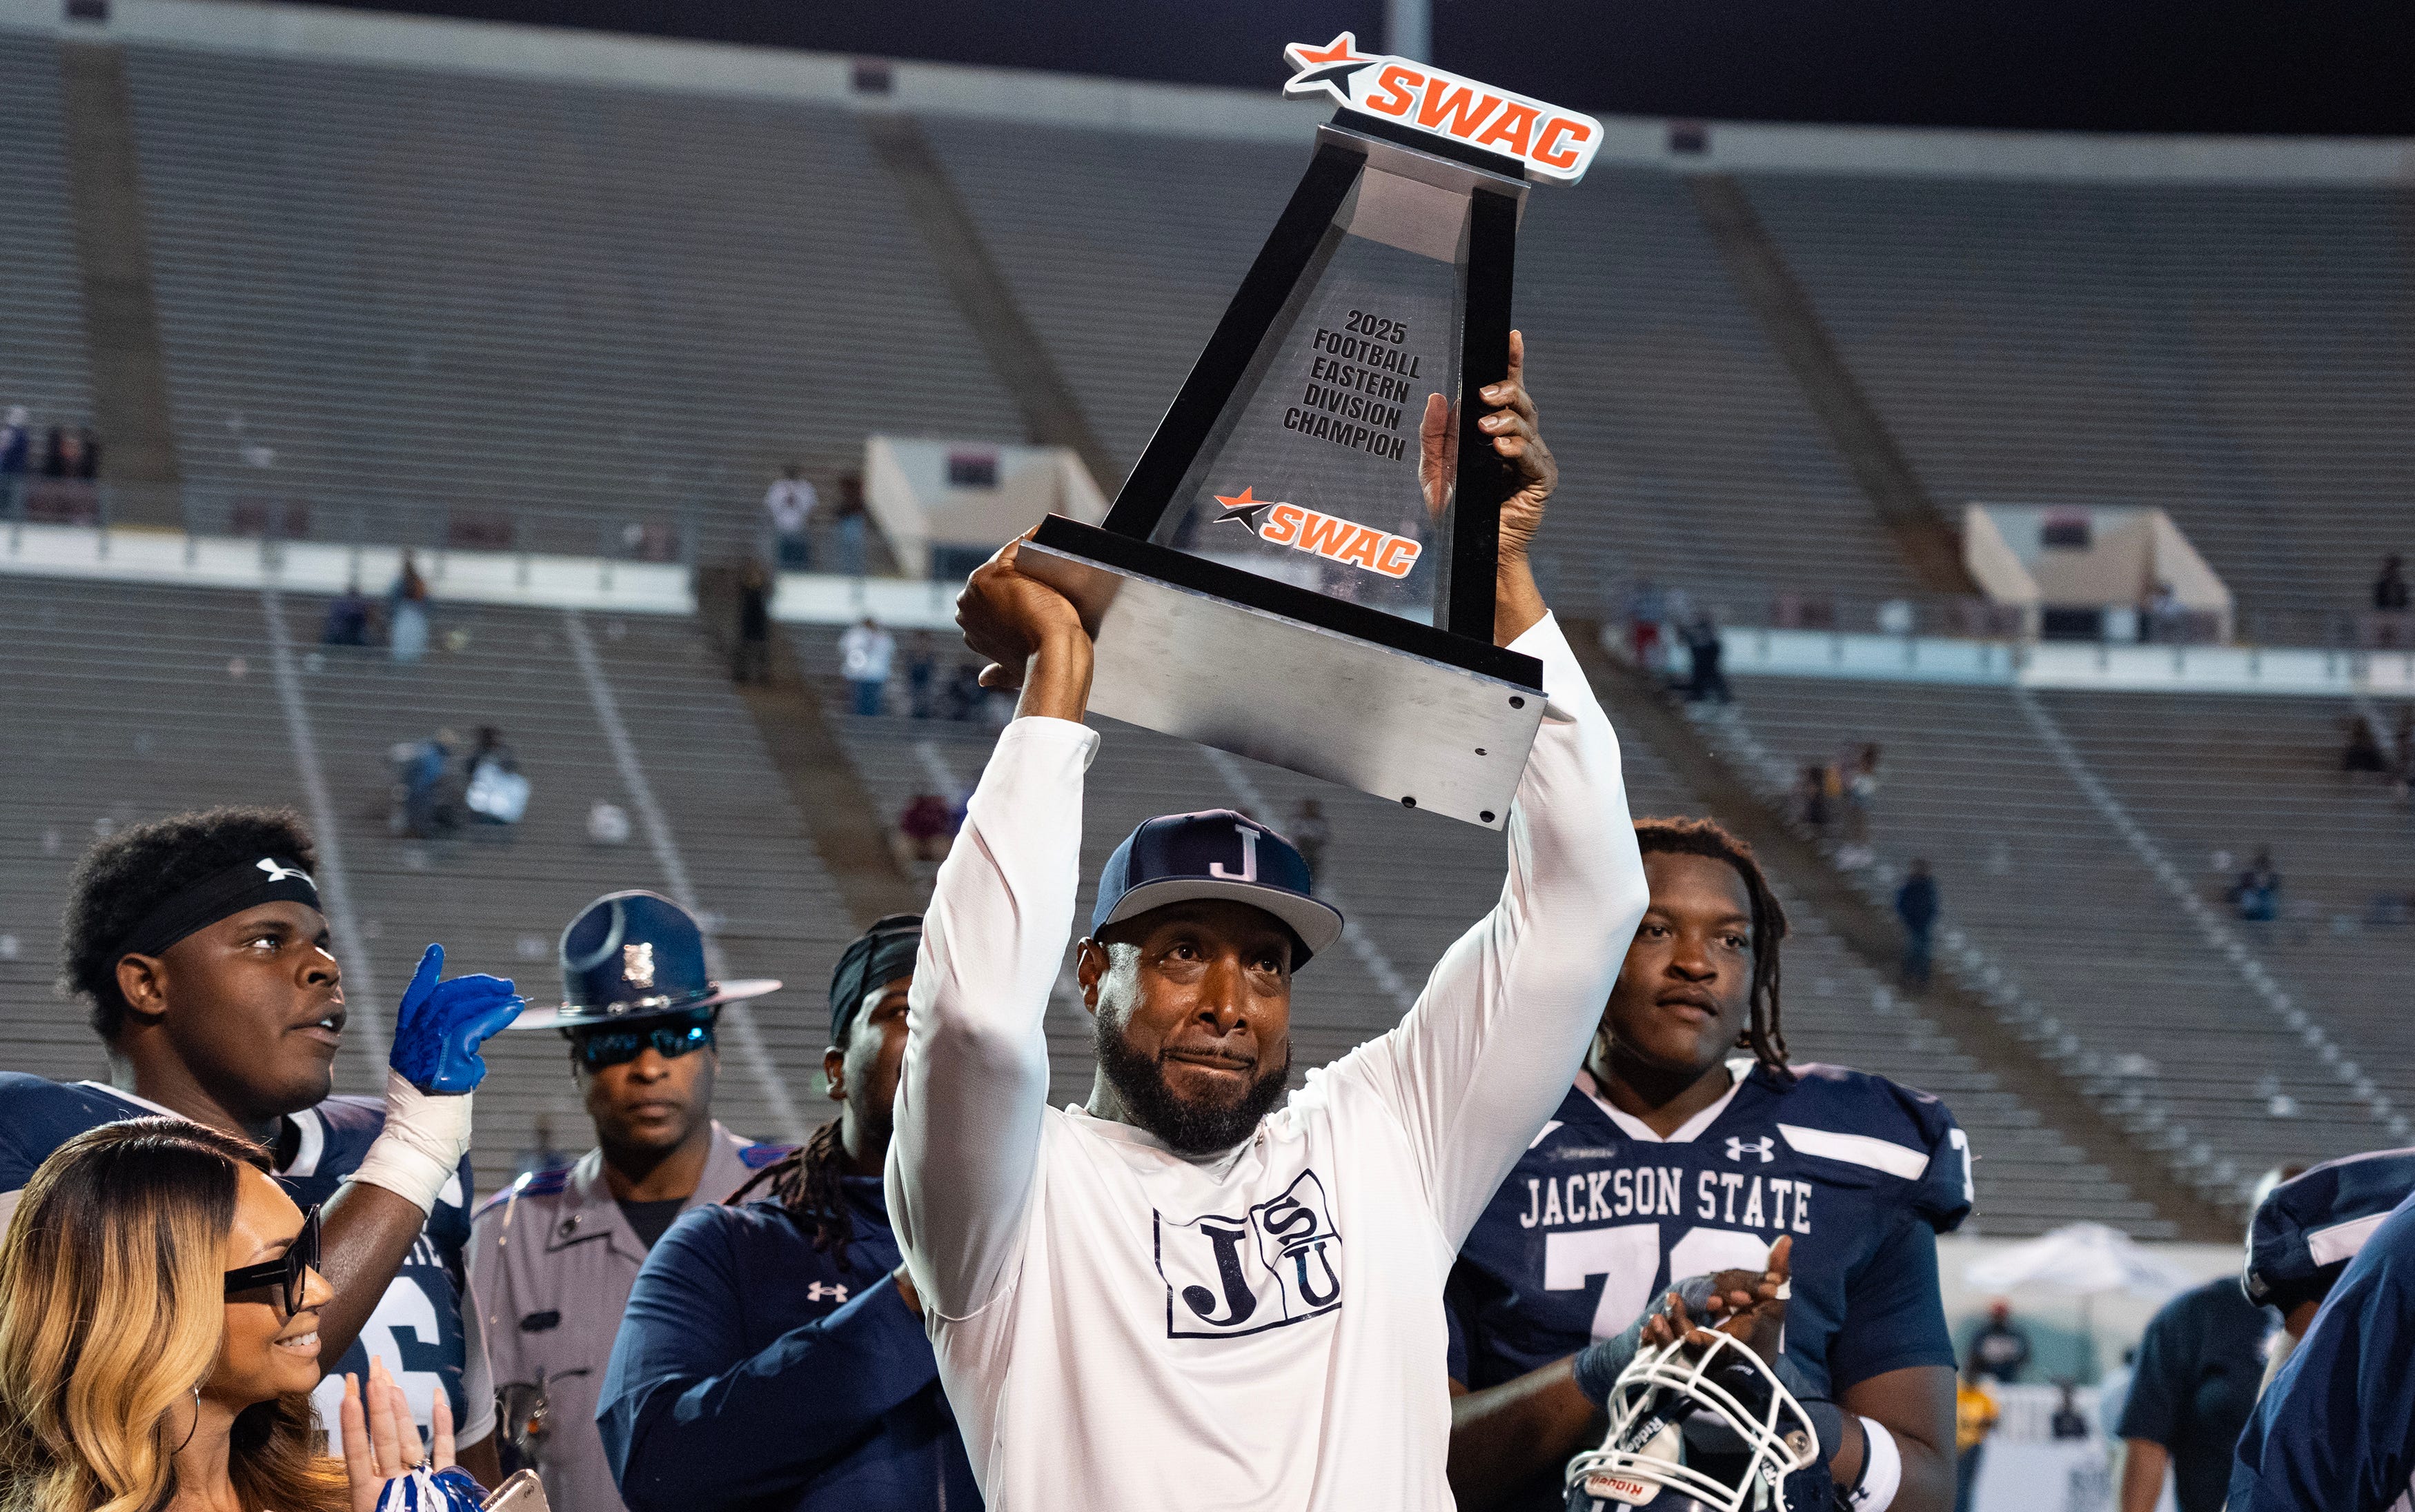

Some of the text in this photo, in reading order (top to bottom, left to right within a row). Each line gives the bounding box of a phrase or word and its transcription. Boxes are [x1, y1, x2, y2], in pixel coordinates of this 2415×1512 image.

[1366, 65, 1591, 169] SWAC
[1312, 328, 1421, 380] FOOTBALL
[1344, 309, 1408, 346] 2025
[1303, 383, 1402, 431] DIVISION
[1310, 357, 1410, 404] EASTERN
[1283, 407, 1406, 461] CHAMPION
[1261, 505, 1420, 577] SWAC
[1209, 824, 1261, 883] J
[1519, 1166, 1813, 1235] JACKSON STATE
[1621, 1415, 1665, 1453] Ridde
